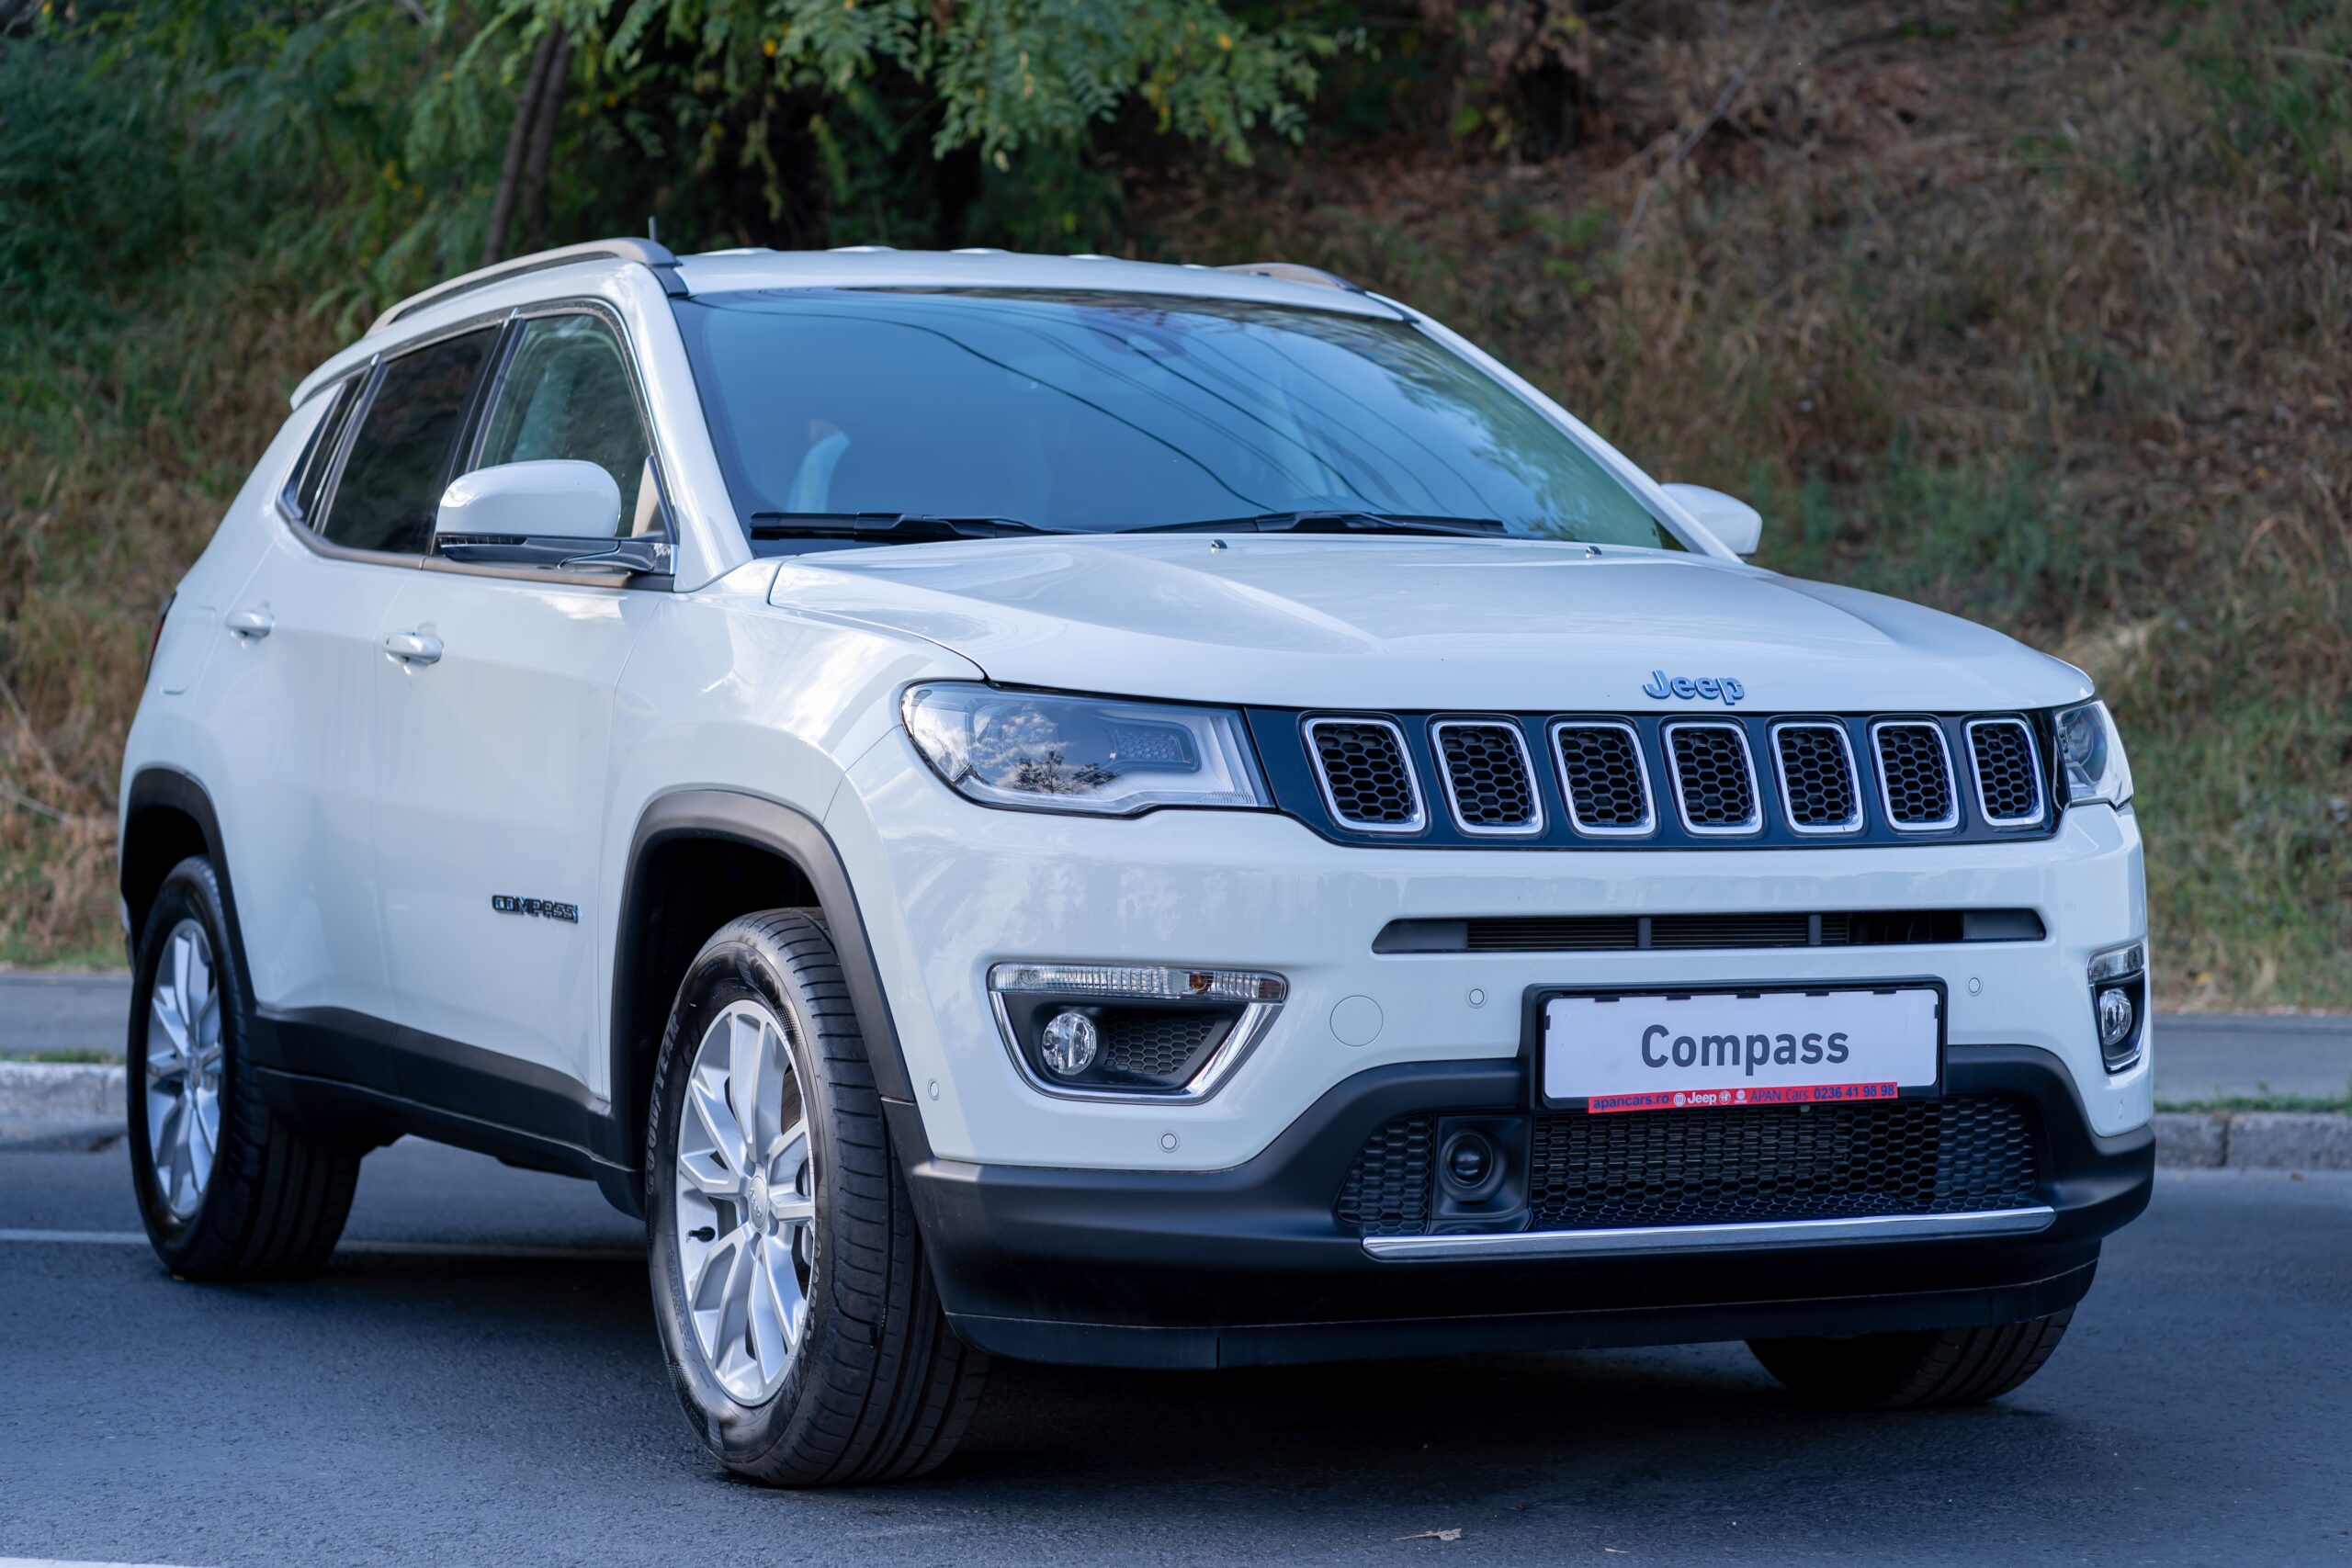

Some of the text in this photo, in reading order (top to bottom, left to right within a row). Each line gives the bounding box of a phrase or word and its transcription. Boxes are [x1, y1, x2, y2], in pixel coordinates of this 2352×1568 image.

[1643, 669, 1744, 705] Jeep
[492, 895, 578, 923] COMPASS
[1642, 1024, 1849, 1076] Compass
[646, 1013, 679, 1195] GOODYEAR
[1593, 1094, 1669, 1111] apancars.ro
[1687, 1091, 1717, 1106] Jeep
[1749, 1089, 1781, 1102] APAN
[1785, 1088, 1809, 1101] Cars
[1814, 1086, 1842, 1100] 0236
[1846, 1085, 1860, 1098] 41
[1863, 1085, 1877, 1098] 98
[1881, 1084, 1895, 1097] 98
